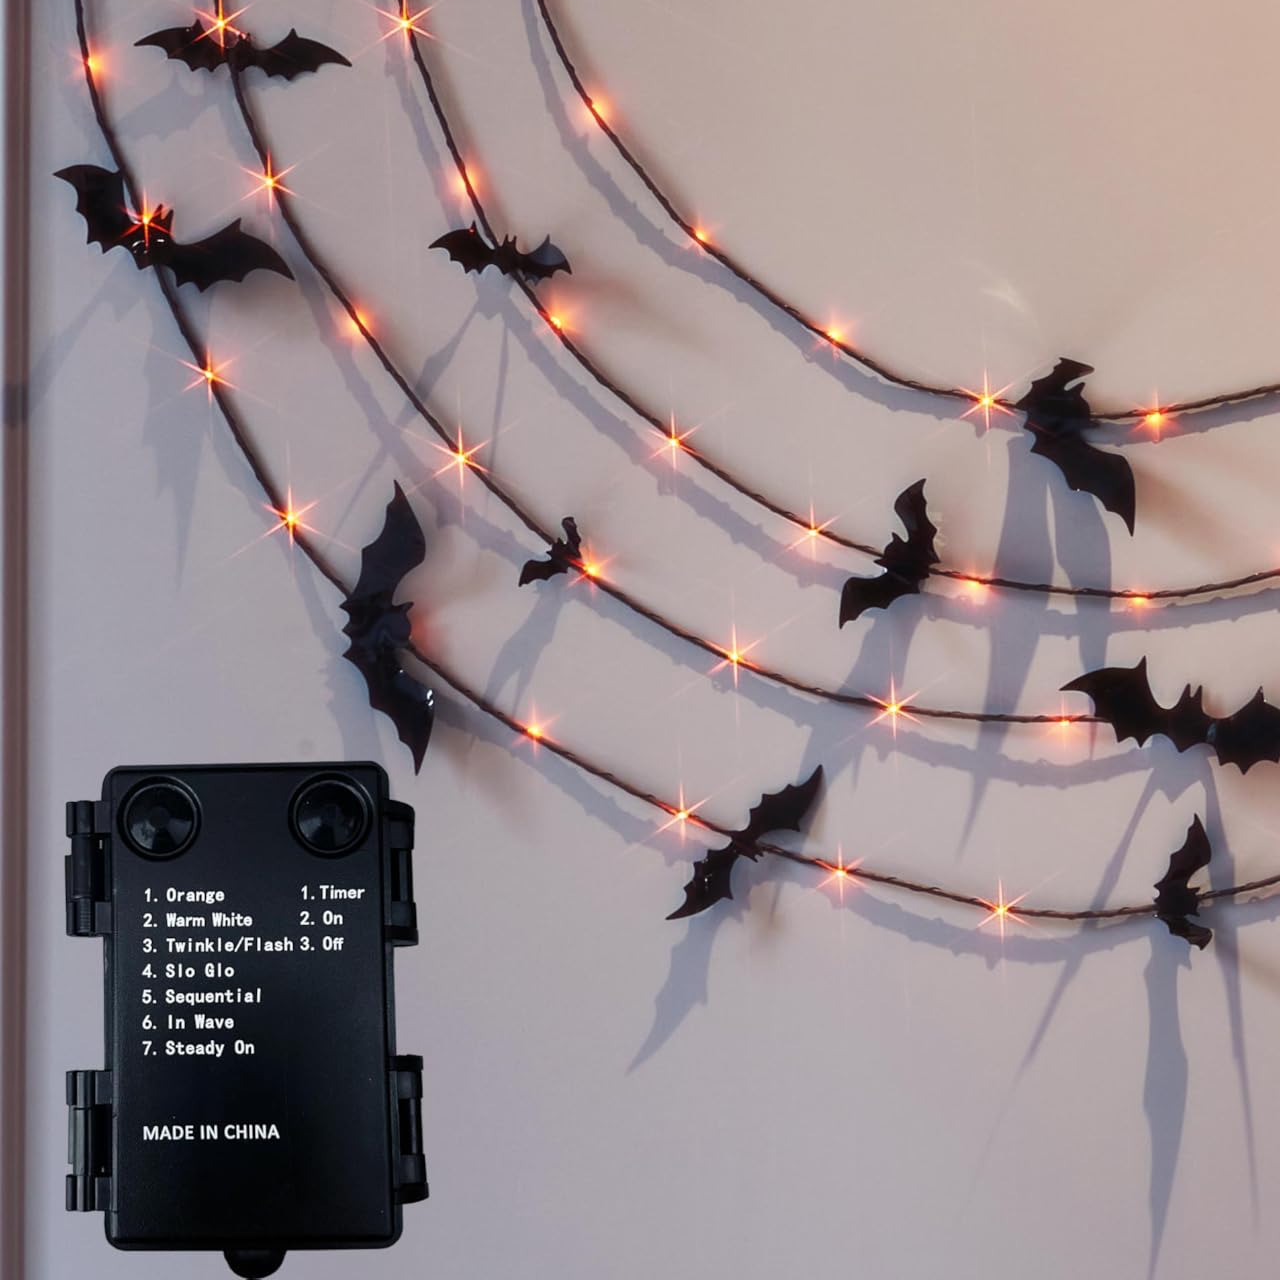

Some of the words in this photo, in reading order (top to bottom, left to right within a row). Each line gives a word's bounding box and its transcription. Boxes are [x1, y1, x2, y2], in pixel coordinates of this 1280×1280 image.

[144, 887, 159, 903] 1.
[165, 887, 225, 905] Orange
[300, 884, 316, 901] 1.
[319, 884, 366, 900] Timer
[142, 912, 158, 928] 2.
[165, 912, 206, 928] Warm
[211, 911, 253, 928] White
[299, 910, 316, 926] 2.
[322, 909, 344, 926] On
[142, 937, 158, 954] 3.
[165, 935, 294, 953] Twinkle/Flash
[299, 935, 316, 952] 3.
[321, 935, 345, 952] Off
[141, 963, 158, 979] 4.
[164, 962, 196, 979] Slo
[204, 962, 235, 979] Glo
[141, 988, 158, 1005] 5.
[164, 987, 262, 1007] Sequential
[141, 1014, 158, 1030] 6.
[167, 1013, 186, 1030] In
[193, 1013, 235, 1030] Wave
[141, 1040, 157, 1056] 7.
[164, 1039, 225, 1058] Steady
[234, 1039, 255, 1055] On
[142, 1124, 195, 1141] MADE
[199, 1124, 219, 1140] IN
[223, 1123, 281, 1140] CHINA
